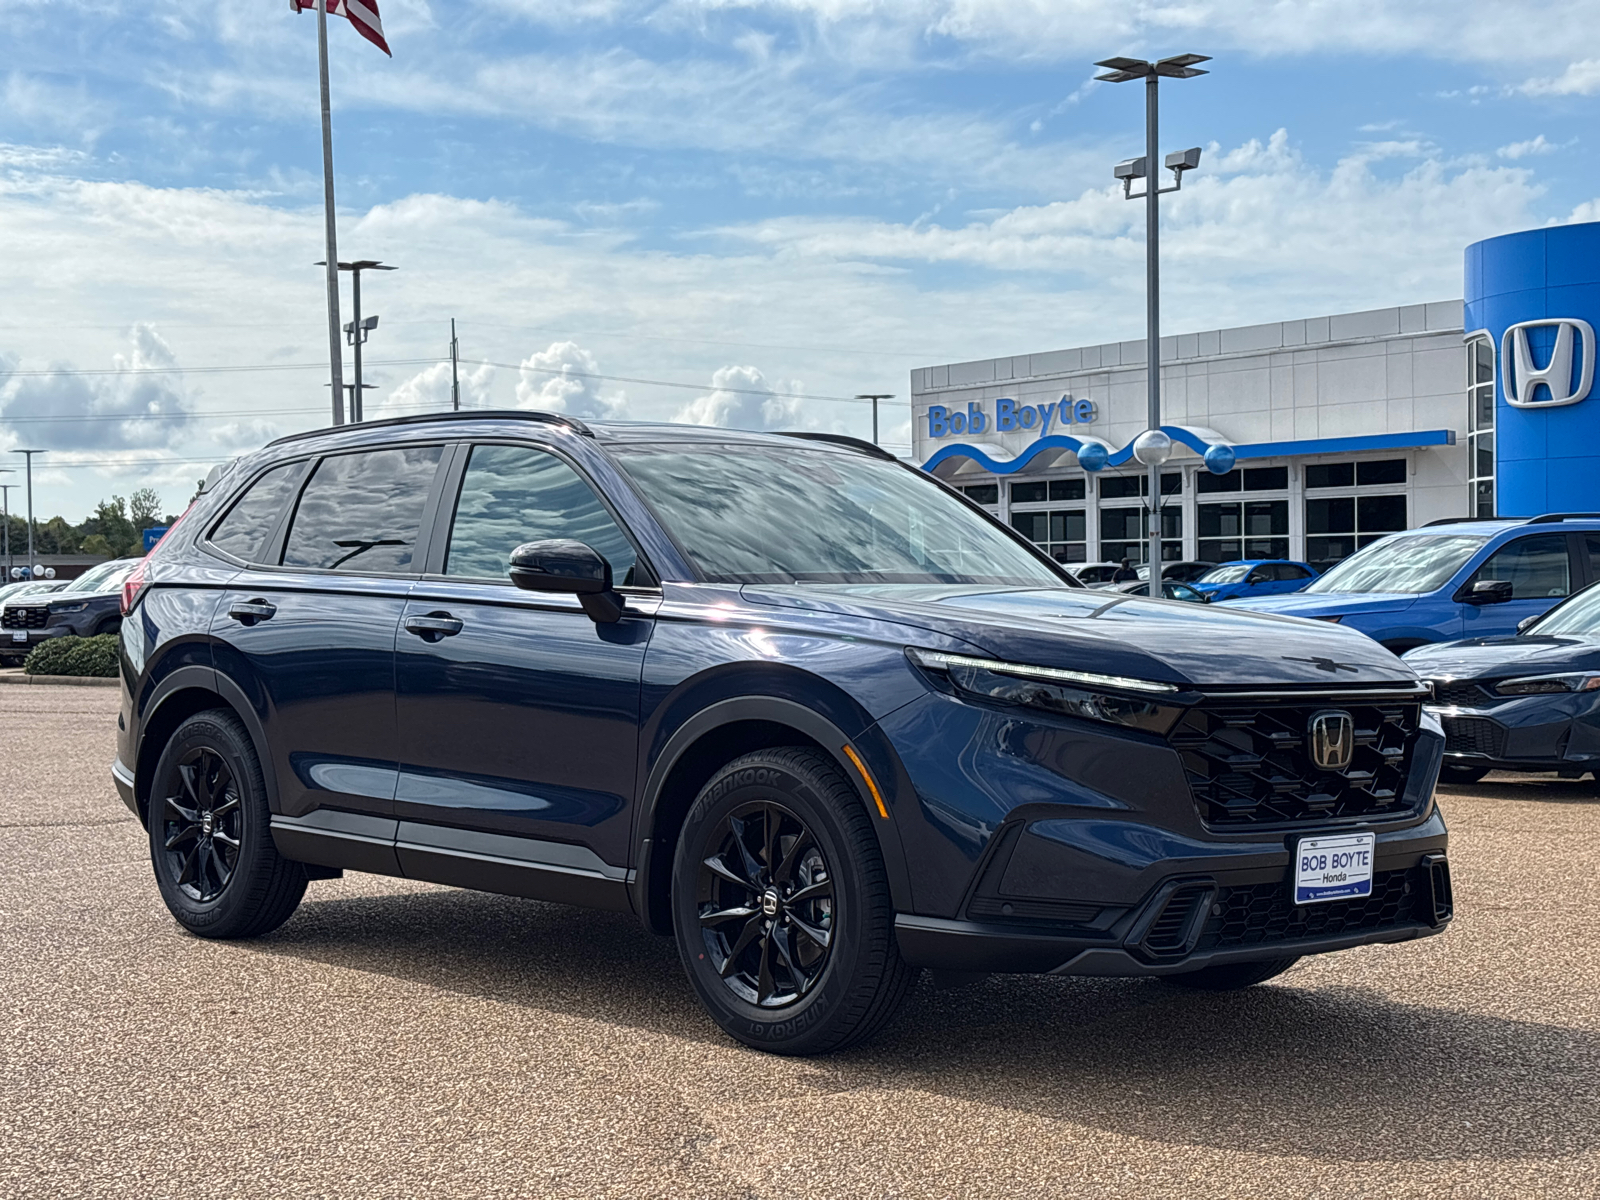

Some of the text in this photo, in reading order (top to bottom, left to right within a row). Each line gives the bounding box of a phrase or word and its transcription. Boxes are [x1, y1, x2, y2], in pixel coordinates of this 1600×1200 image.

[929, 394, 1094, 438] Bob Boyte
[1301, 850, 1370, 872] BOB BOYTE
[1322, 871, 1347, 884] Honda
